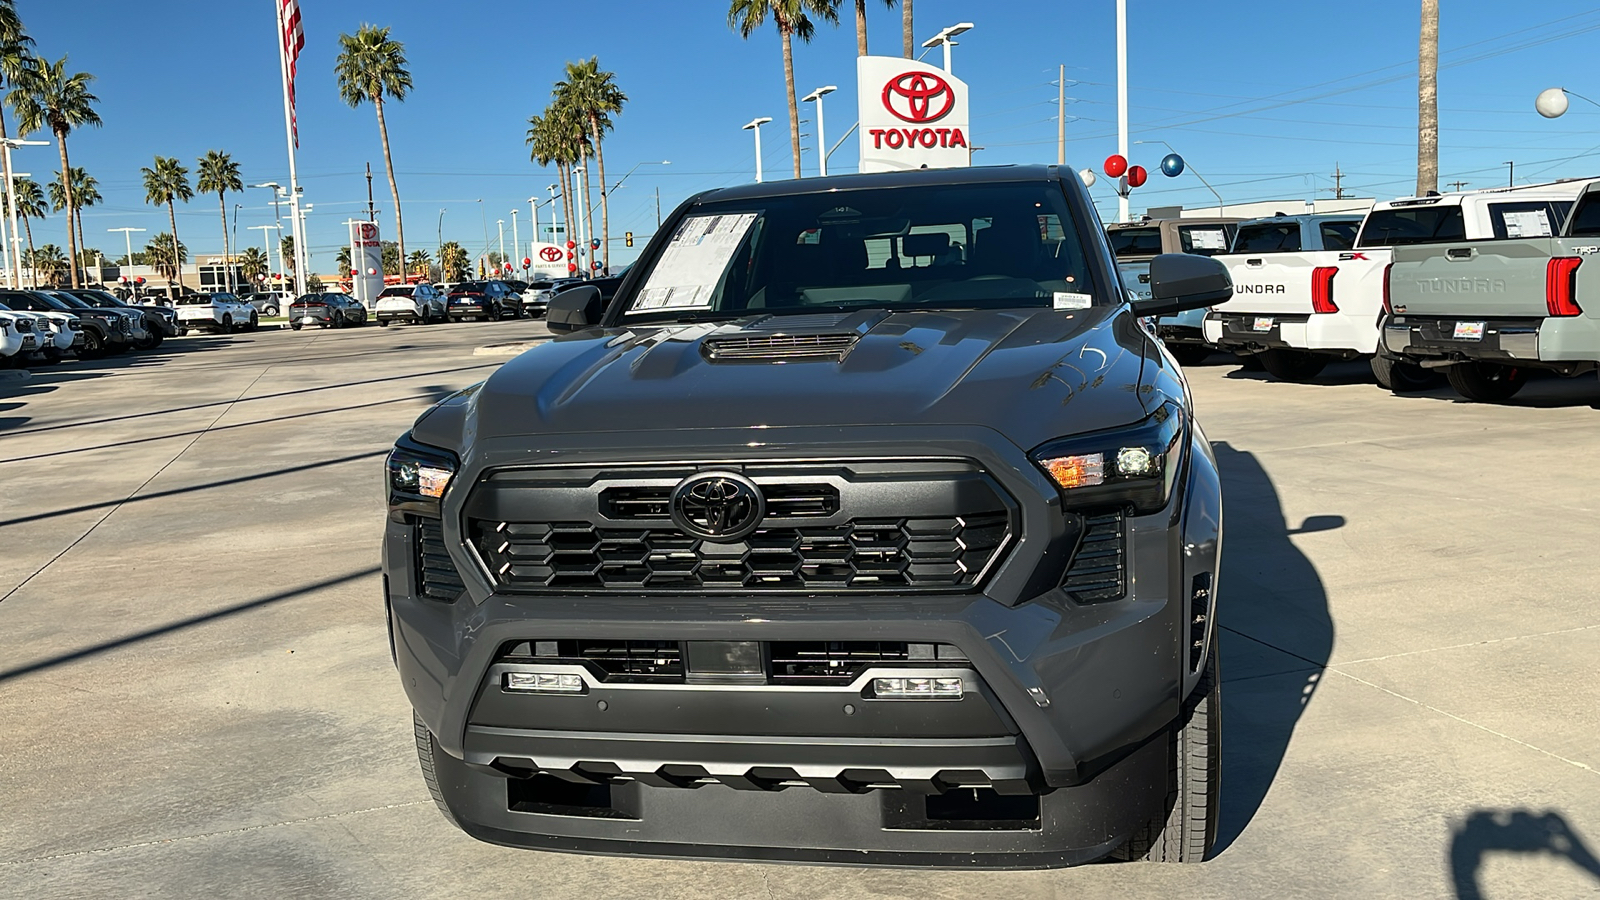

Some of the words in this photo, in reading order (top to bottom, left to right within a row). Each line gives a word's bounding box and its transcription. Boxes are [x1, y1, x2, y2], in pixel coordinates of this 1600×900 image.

[869, 128, 967, 149] TOYOTA
[354, 240, 380, 248] TYOTA
[1571, 246, 1598, 255] TRD
[1338, 252, 1371, 261] SX
[1235, 284, 1286, 294] UNDRA
[1416, 278, 1507, 293] TUNDRA
